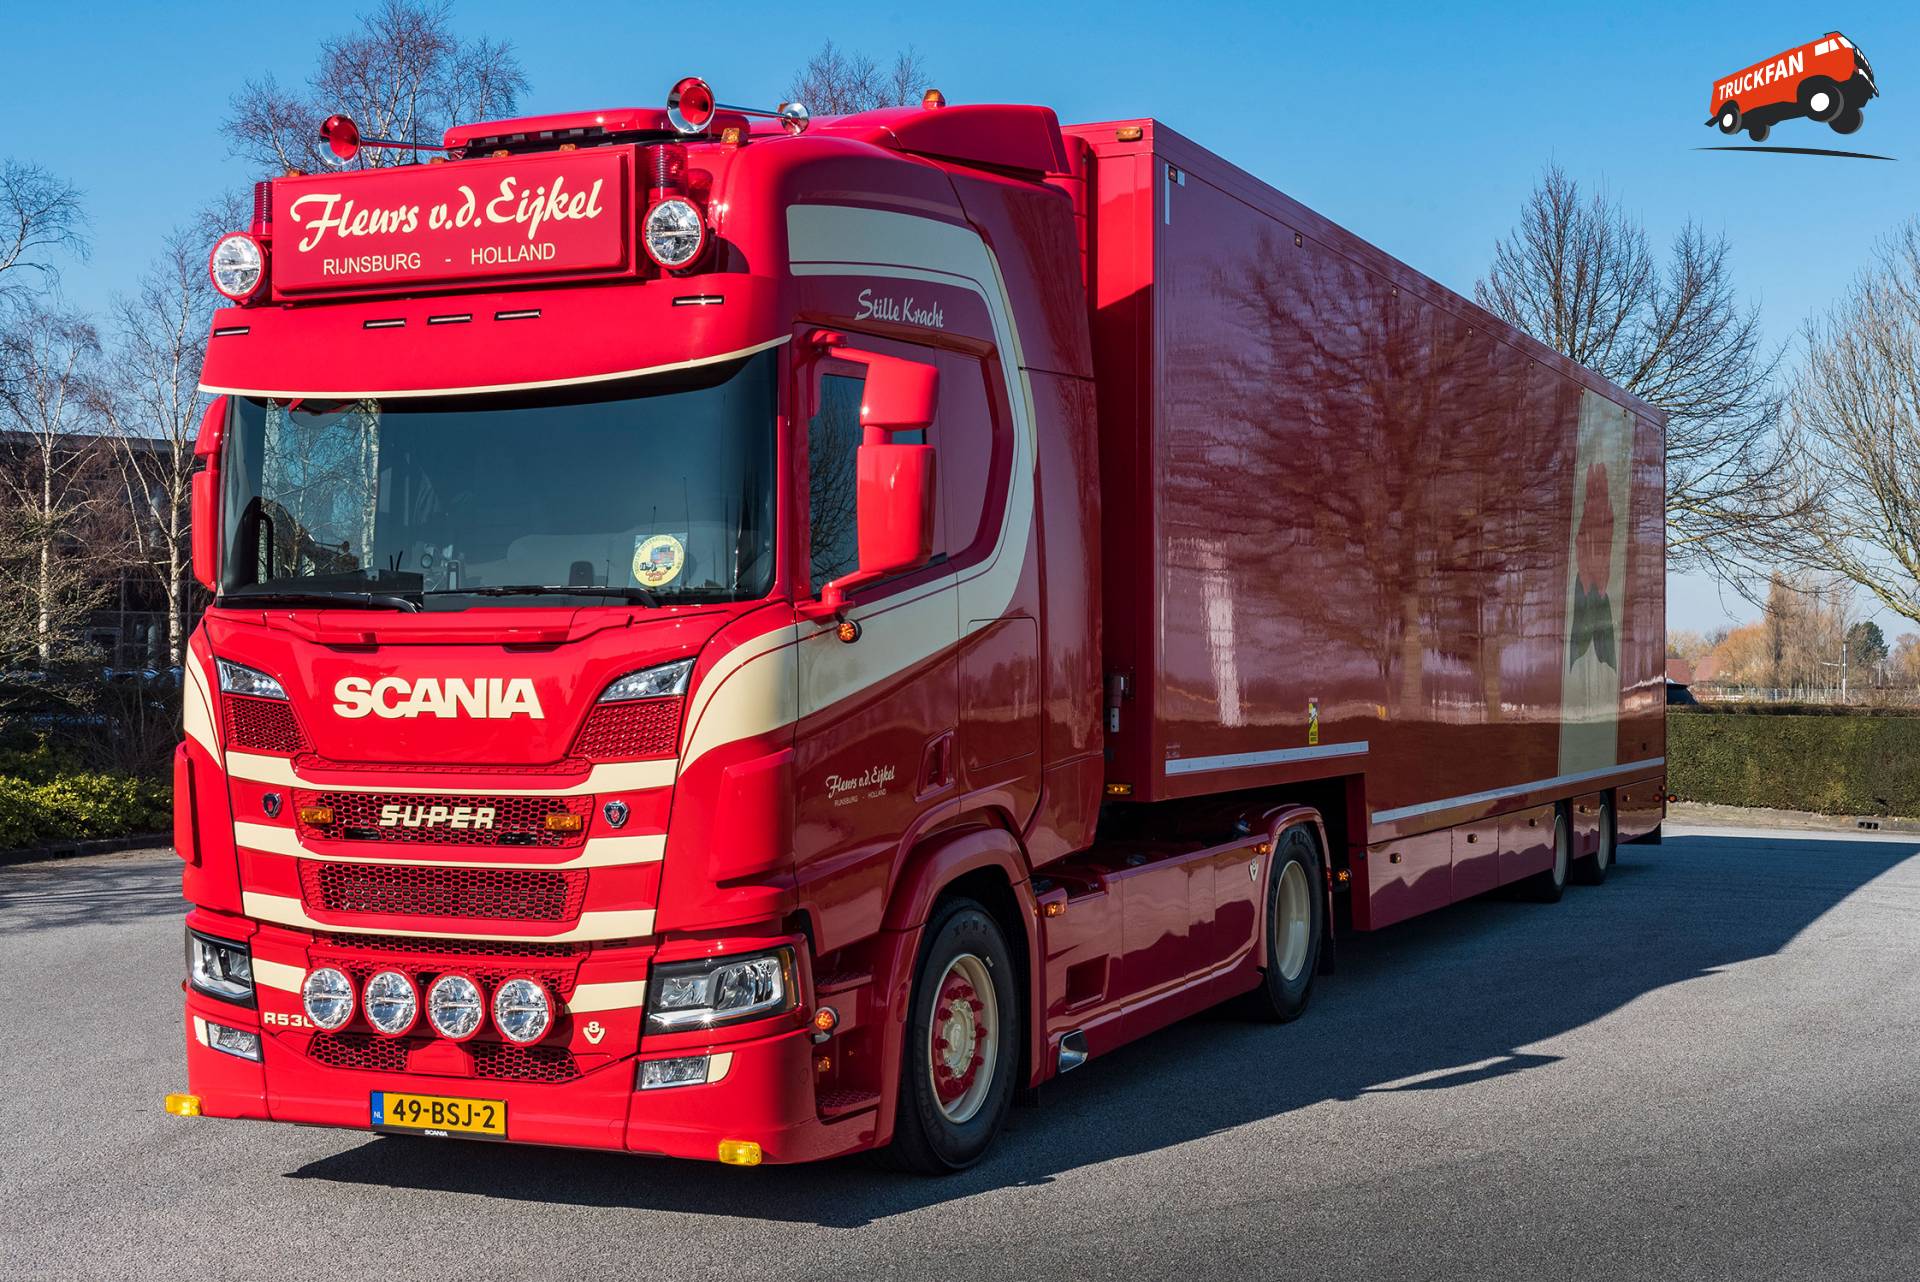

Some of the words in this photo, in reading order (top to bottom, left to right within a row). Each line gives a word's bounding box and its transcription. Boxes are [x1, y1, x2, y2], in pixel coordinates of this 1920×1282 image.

[289, 193, 420, 253] Fleurs
[323, 252, 421, 276] RIJNSBURG
[471, 242, 556, 266] HOLLAND
[854, 288, 899, 322] Stille
[901, 296, 944, 328] Kracht
[332, 676, 545, 719] SCANIA
[379, 804, 496, 830] SUPER
[373, 1111, 383, 1119] NL
[392, 1098, 496, 1129] 49-BSJ-2
[424, 1129, 448, 1137] SCANIA
